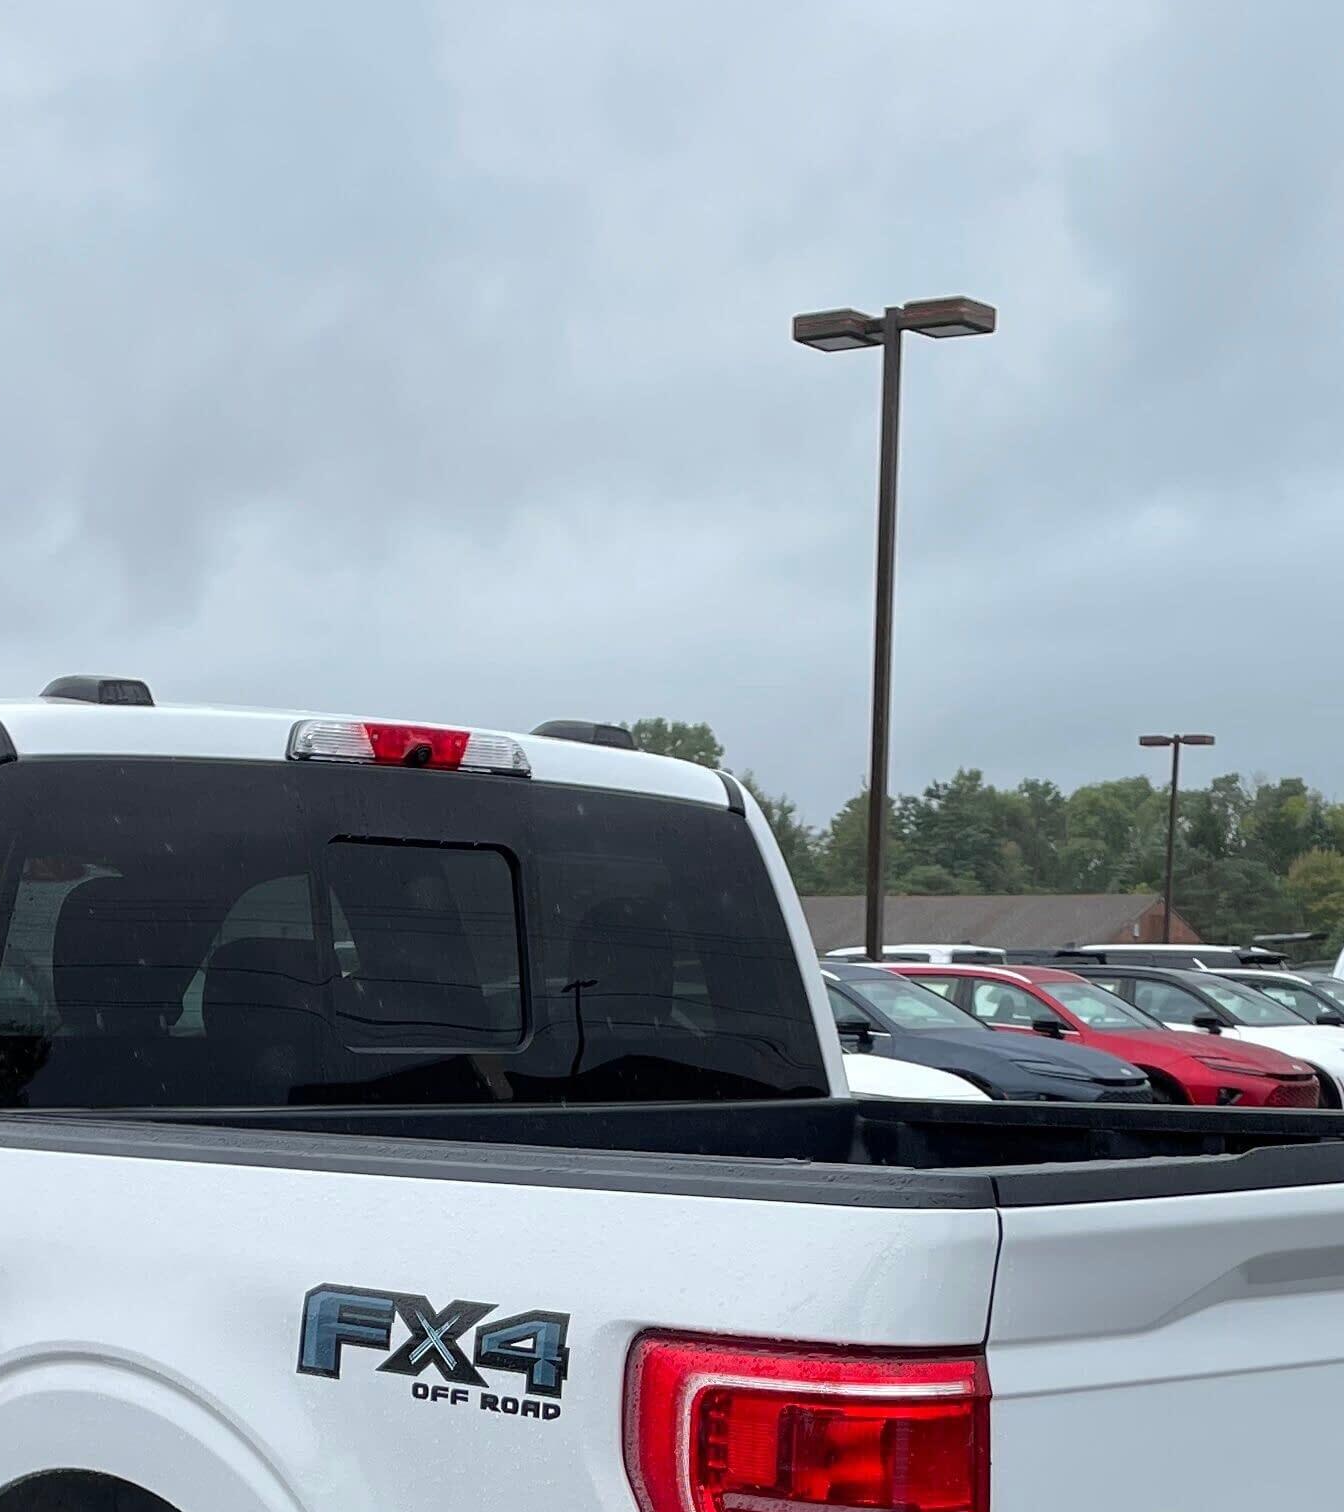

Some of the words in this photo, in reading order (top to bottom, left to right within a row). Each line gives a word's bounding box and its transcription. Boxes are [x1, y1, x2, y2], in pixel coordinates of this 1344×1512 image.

[296, 1283, 571, 1399] FX4
[412, 1382, 468, 1405] OFF
[480, 1392, 561, 1421] ROAD
